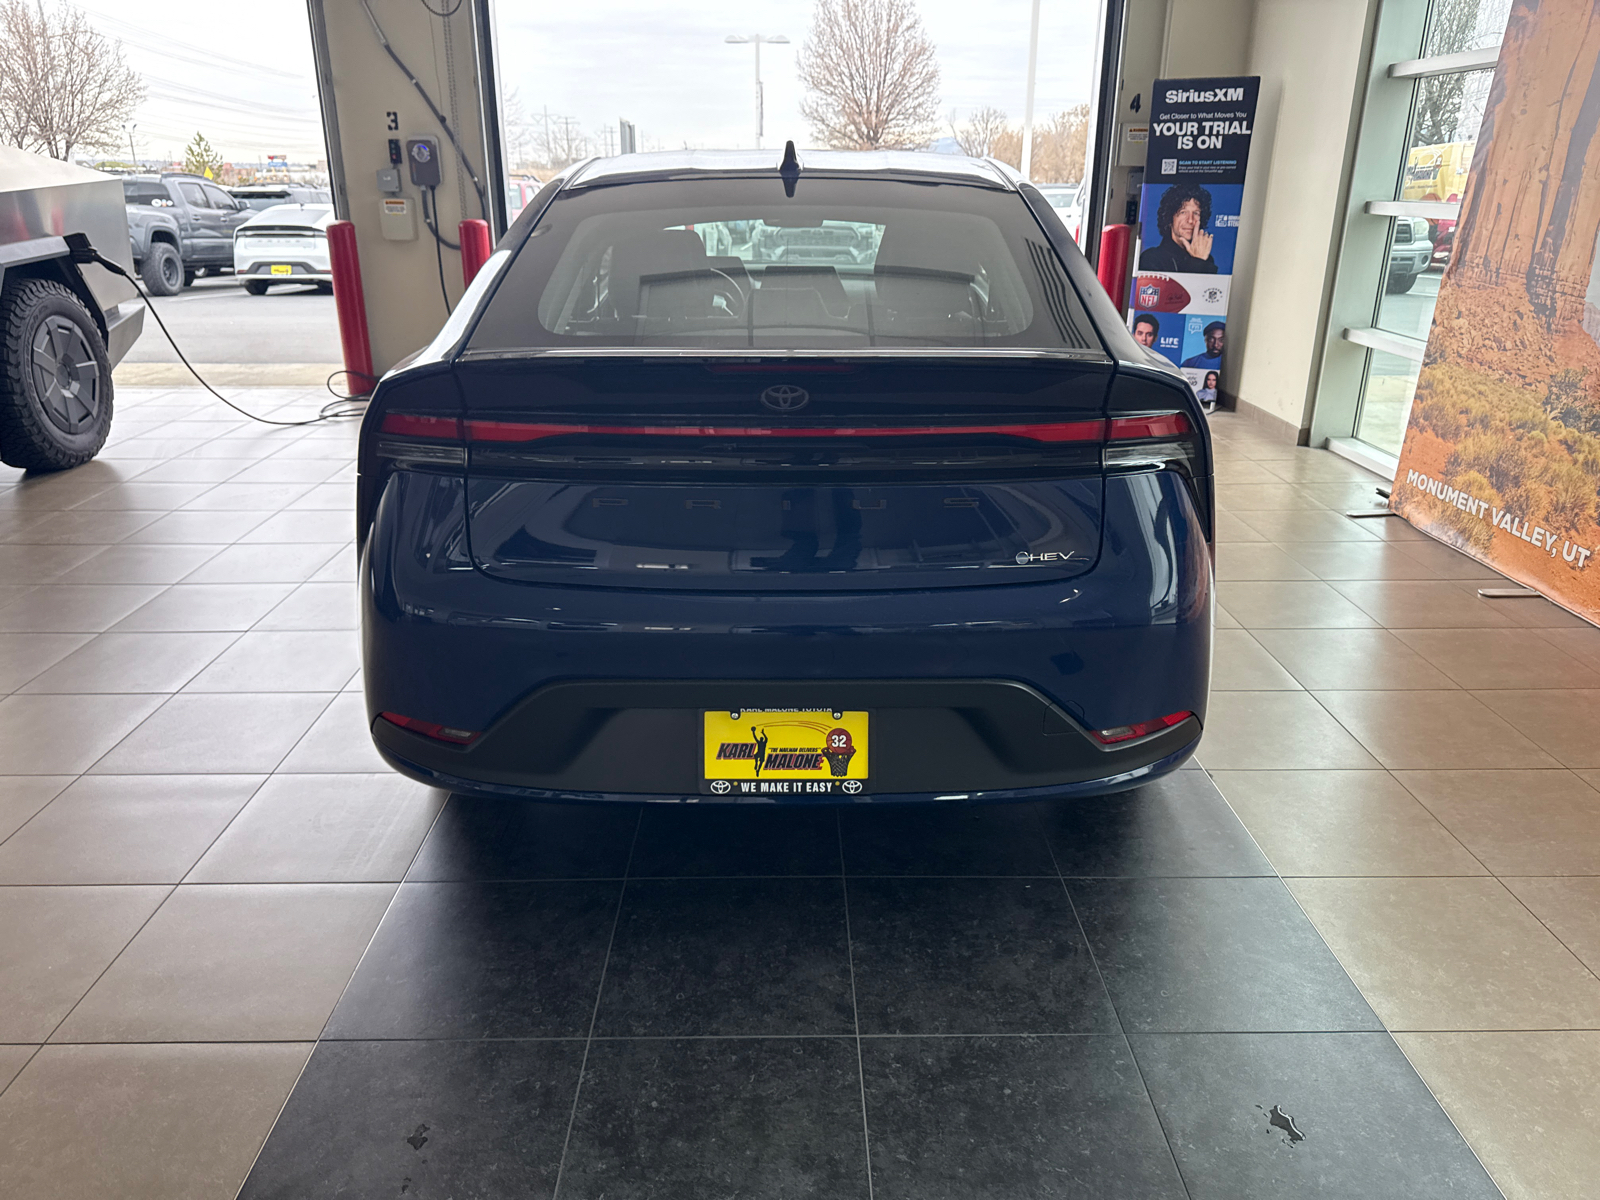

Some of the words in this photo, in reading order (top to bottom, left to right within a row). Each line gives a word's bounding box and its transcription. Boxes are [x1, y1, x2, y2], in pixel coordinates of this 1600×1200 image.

[1130, 93, 1141, 113] 4
[1165, 88, 1243, 103] SiriusXM
[386, 111, 399, 131] 3
[1153, 122, 1198, 136] YOUR
[1202, 121, 1251, 135] TRIAL
[1177, 136, 1193, 149] IS
[1197, 136, 1222, 149] ON
[1141, 295, 1158, 306] NFL
[1160, 336, 1179, 344] LIFE
[1406, 468, 1489, 520] MONUMENT
[1492, 507, 1558, 558] VALLEY,
[1562, 540, 1591, 568] UT
[831, 734, 847, 748] 32
[716, 743, 758, 760] KARL
[763, 753, 824, 770] MALONE
[741, 782, 756, 793] WE
[761, 782, 789, 793] MAKE
[793, 782, 803, 793] IT
[806, 782, 833, 793] EASY
